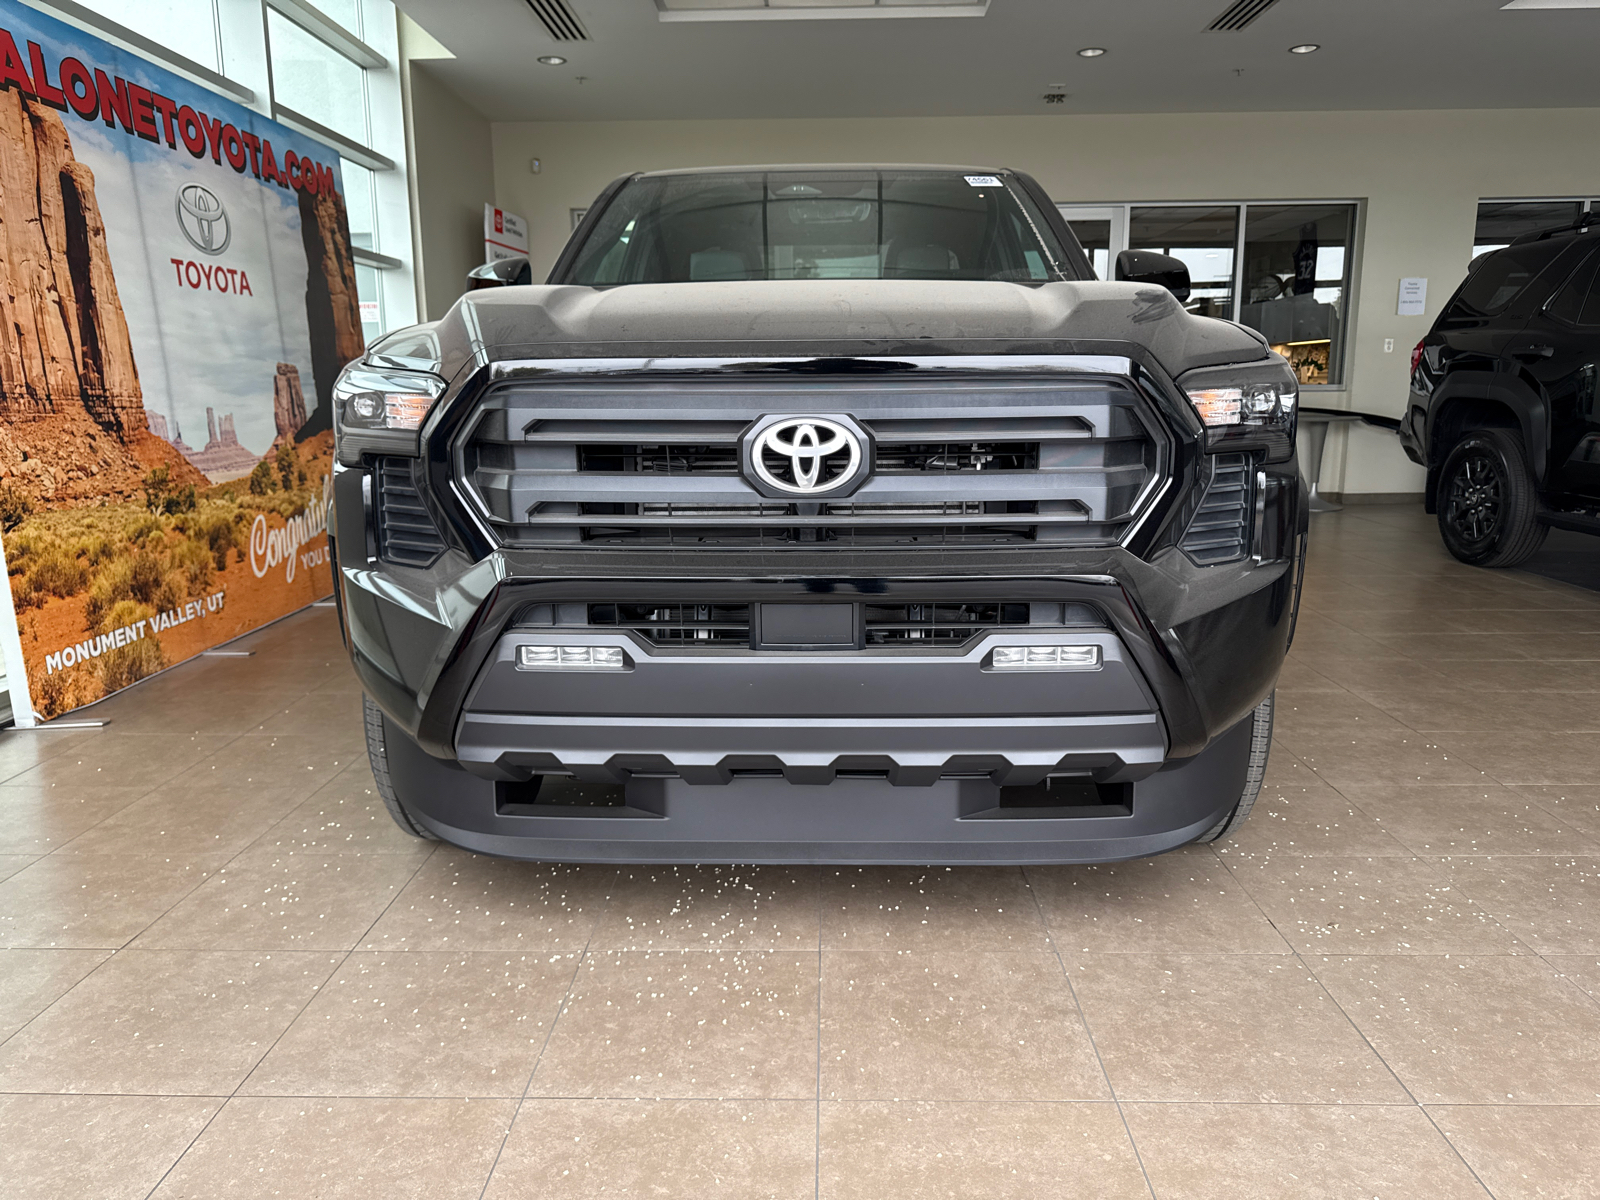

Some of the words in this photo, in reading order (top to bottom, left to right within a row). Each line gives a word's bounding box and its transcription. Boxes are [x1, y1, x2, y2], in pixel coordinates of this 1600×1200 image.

[170, 258, 253, 297] TOYOTA
[1297, 259, 1314, 280] 32
[301, 548, 322, 570] YOU
[45, 620, 147, 675] MONUMENT
[149, 599, 206, 634] VALLEY,
[206, 592, 225, 611] UT
